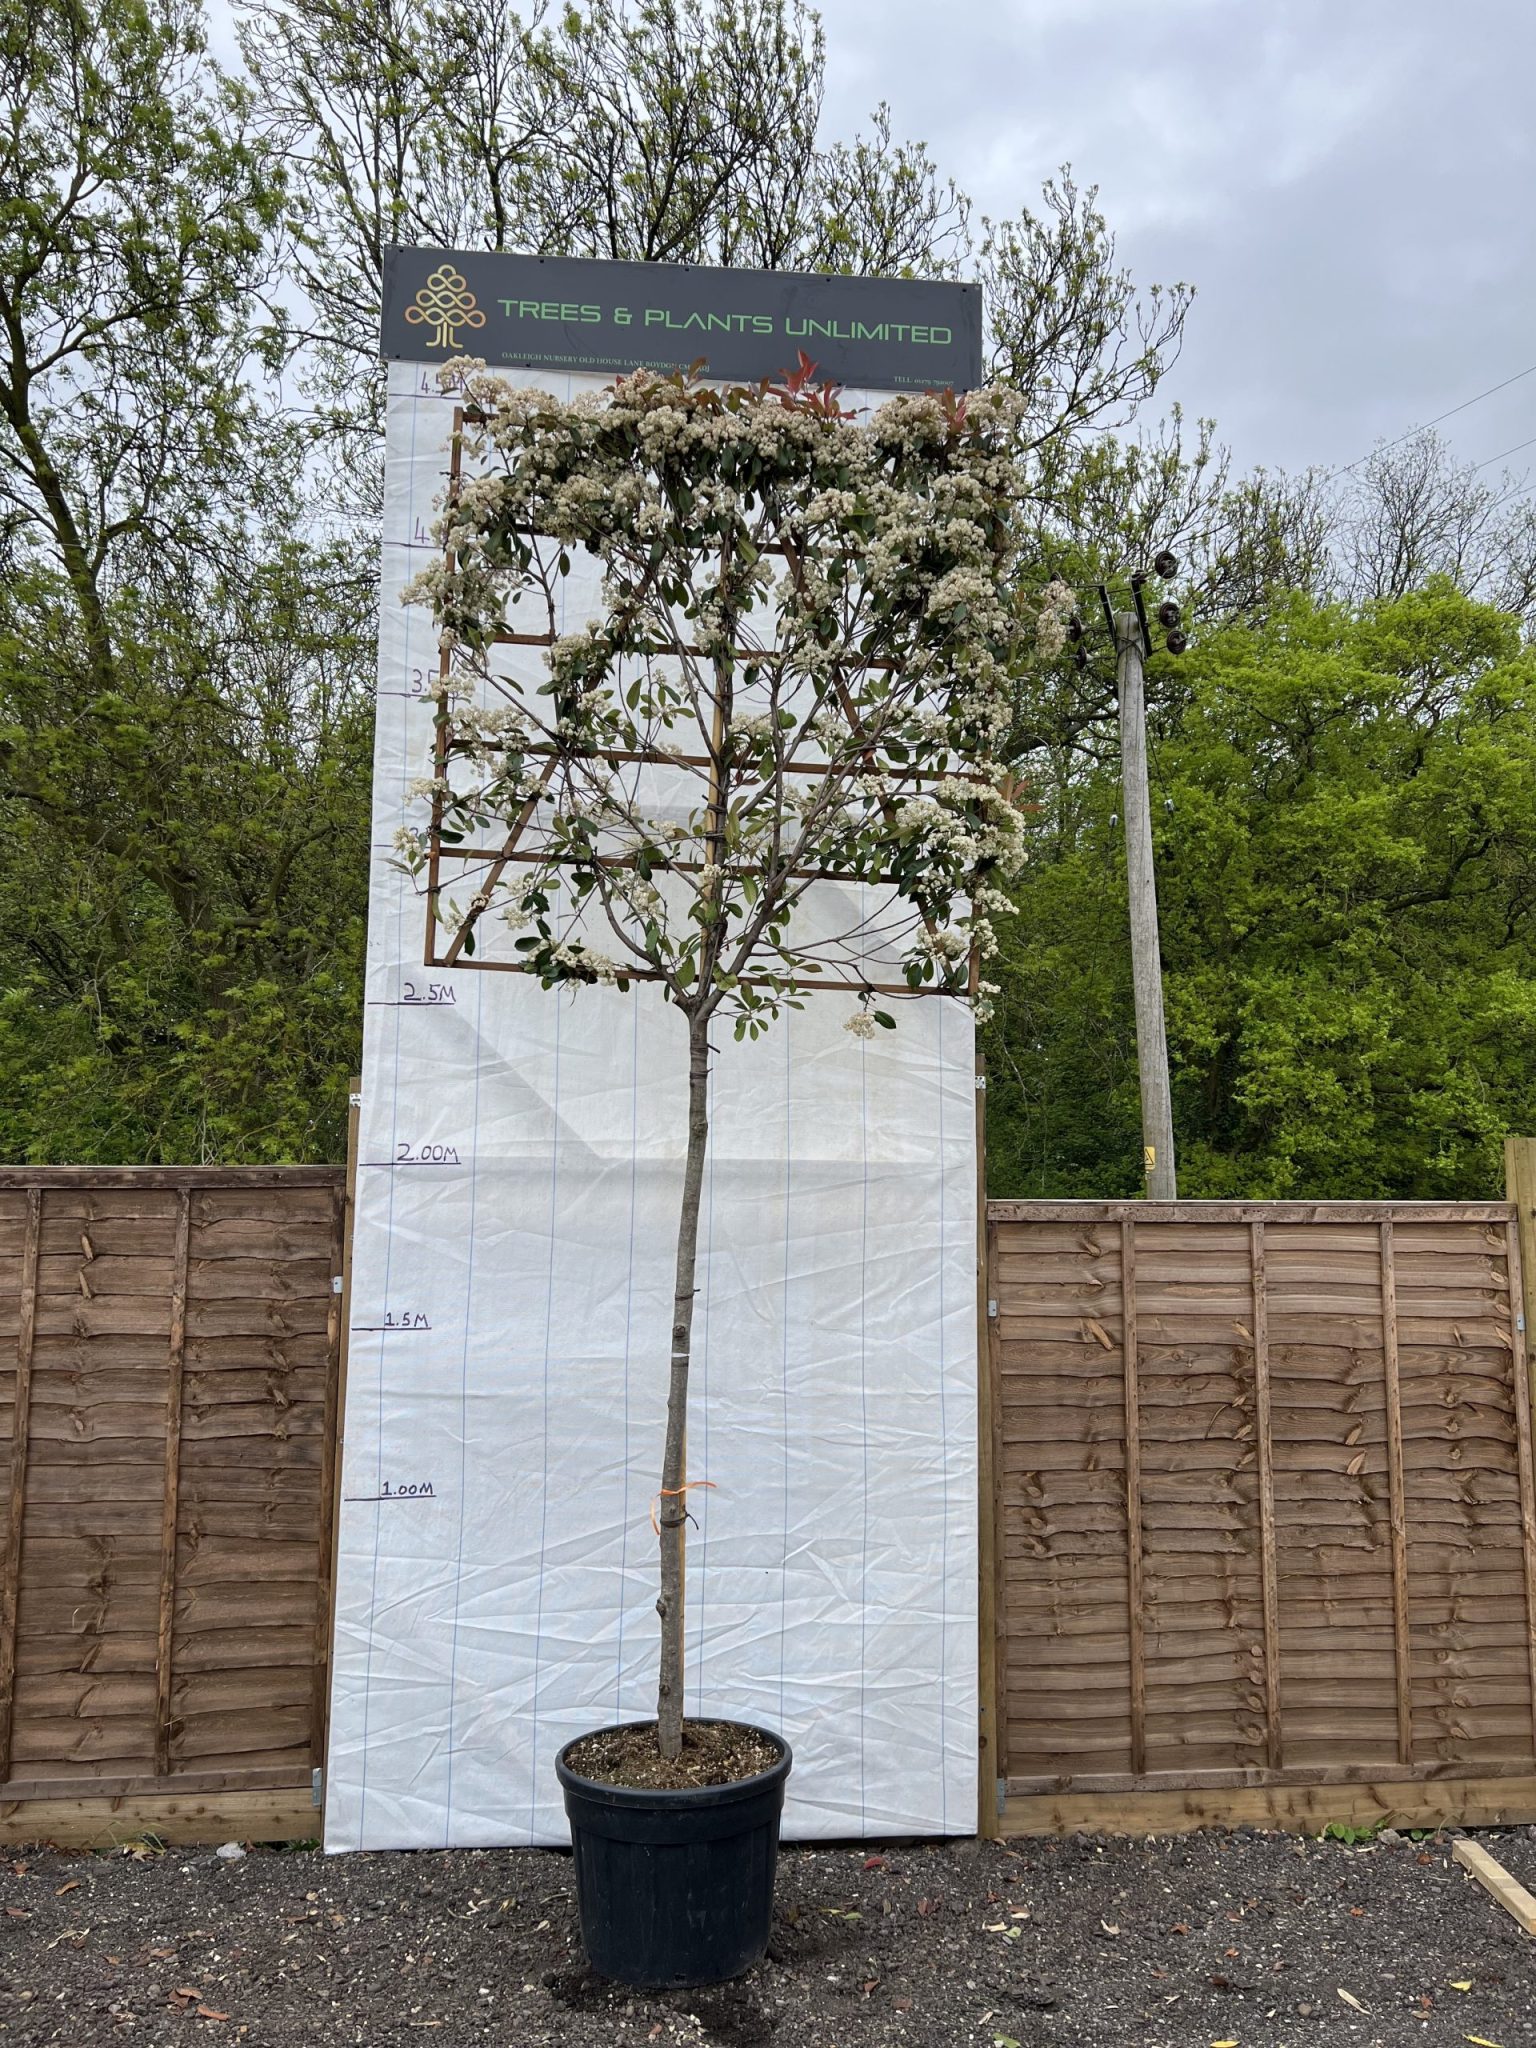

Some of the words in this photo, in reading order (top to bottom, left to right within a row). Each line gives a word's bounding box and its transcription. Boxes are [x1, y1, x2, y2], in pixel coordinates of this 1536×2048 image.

[497, 299, 602, 323] TREES
[613, 307, 633, 325] &
[644, 309, 774, 334] PLANTS
[785, 317, 953, 345] UNLIMITED
[543, 353, 579, 364] NURSERY
[579, 356, 596, 365] OLD
[595, 357, 622, 367] HOUSE
[623, 358, 644, 368] LANE
[403, 982, 457, 1002] 2.5M
[397, 1143, 459, 1163] 2.00M
[380, 1480, 434, 1496] 1.00M
